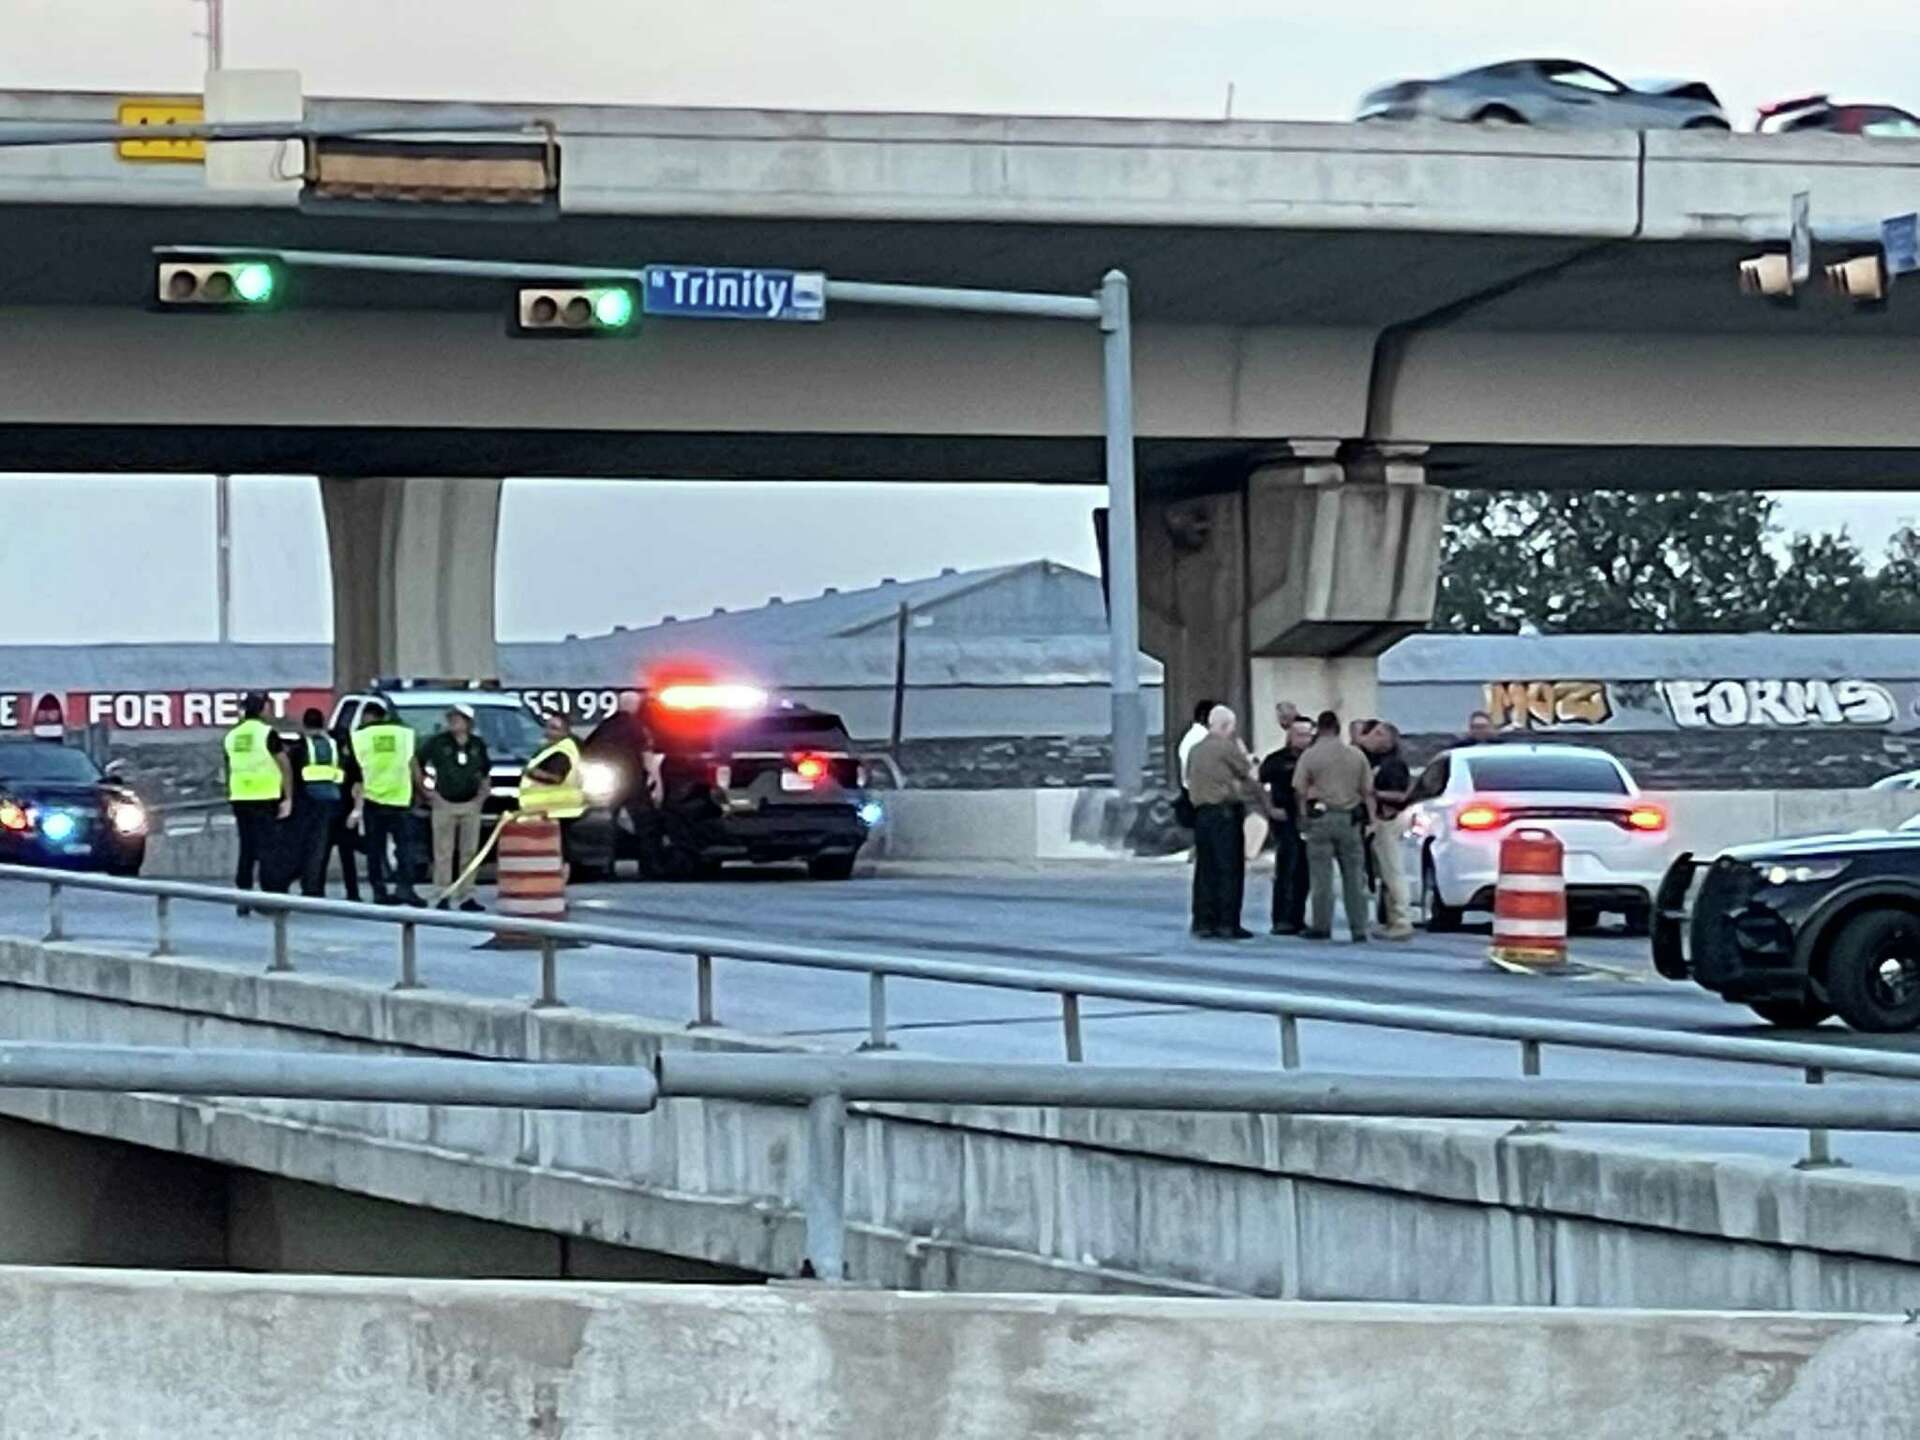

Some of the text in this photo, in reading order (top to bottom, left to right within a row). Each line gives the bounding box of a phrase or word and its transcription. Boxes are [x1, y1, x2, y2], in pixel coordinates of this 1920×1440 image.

[671, 269, 787, 317] Trinity
[88, 692, 173, 728] FOR
[183, 690, 292, 727] RET
[1655, 680, 1899, 727] FORMS
